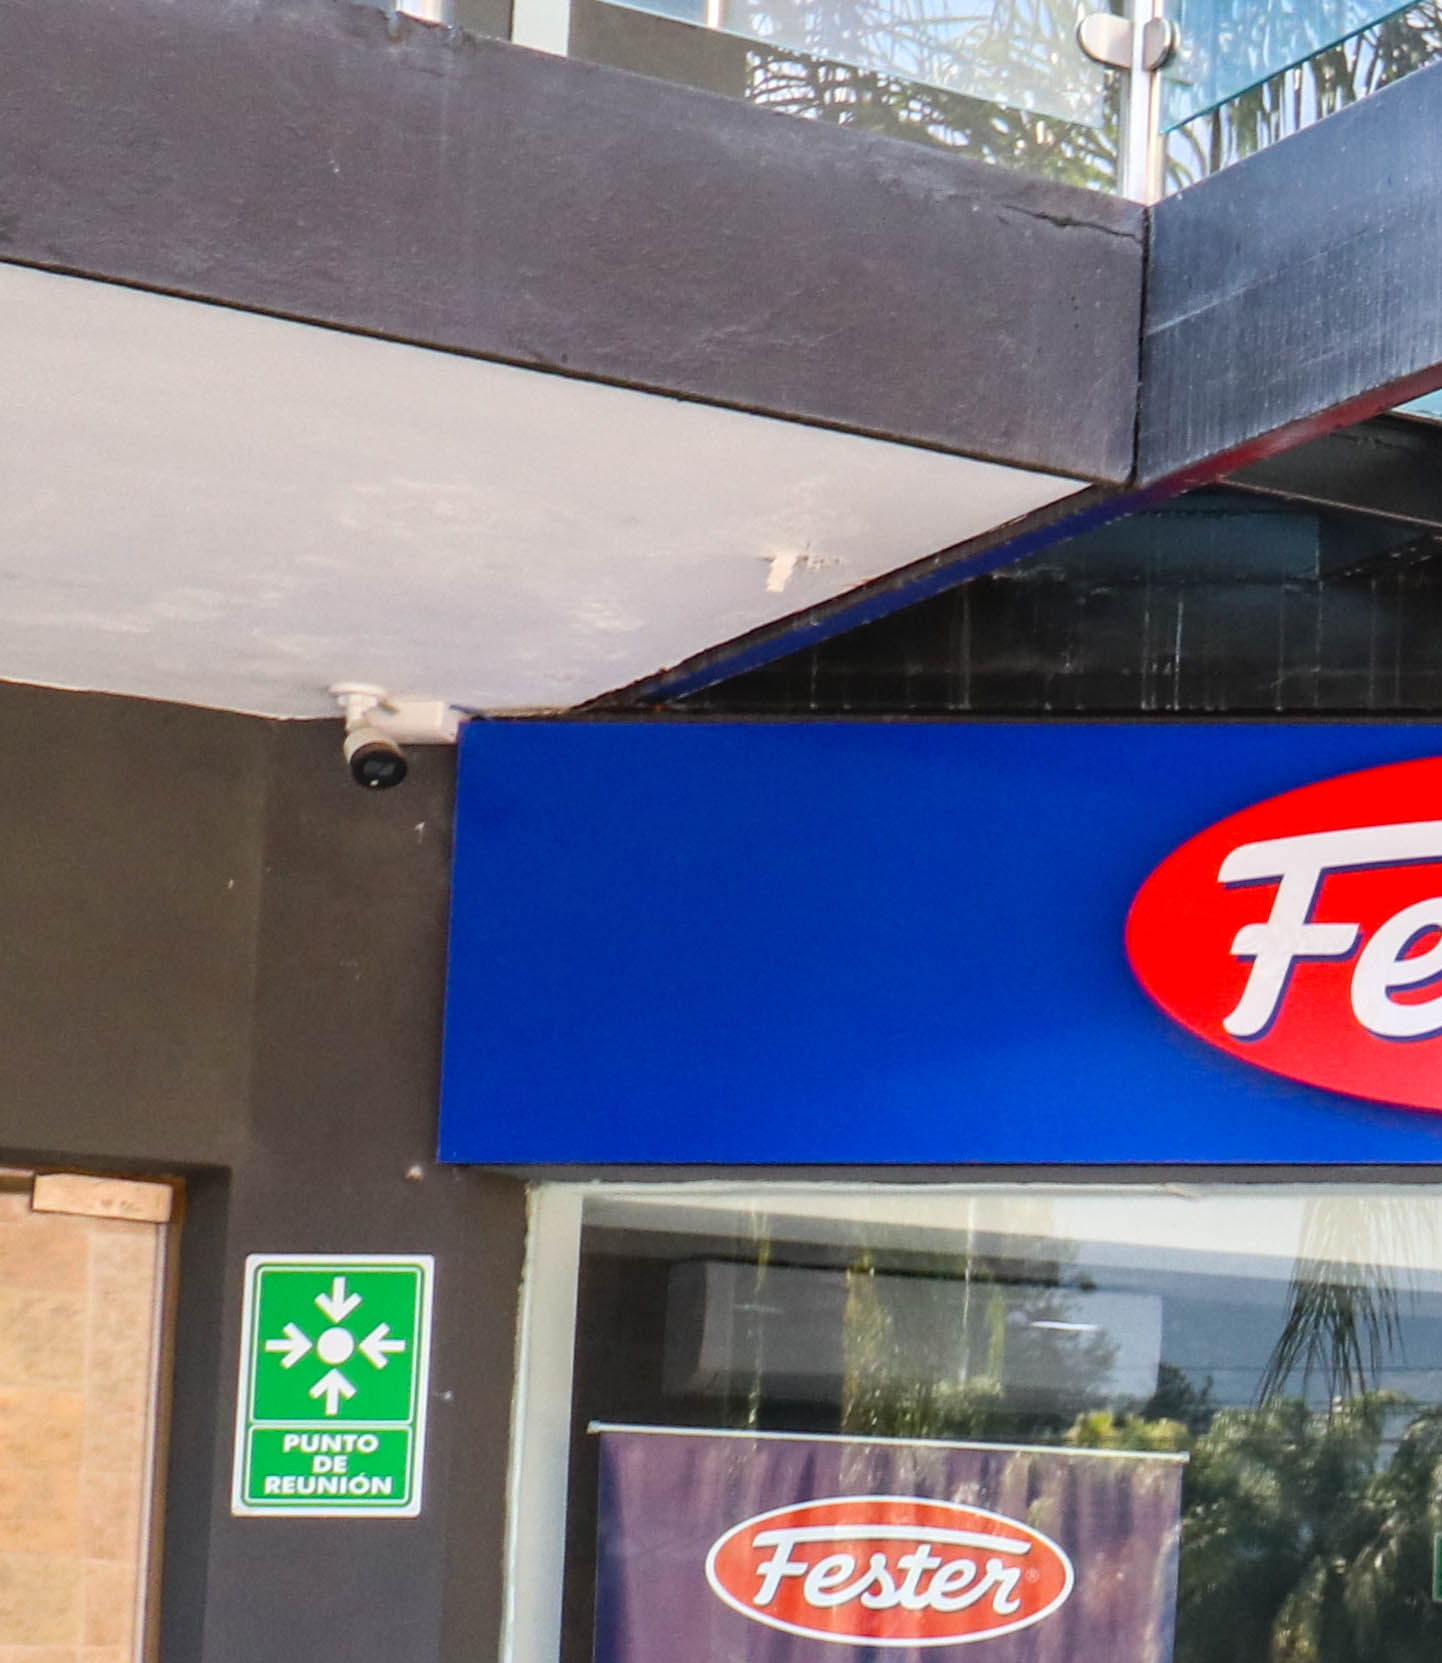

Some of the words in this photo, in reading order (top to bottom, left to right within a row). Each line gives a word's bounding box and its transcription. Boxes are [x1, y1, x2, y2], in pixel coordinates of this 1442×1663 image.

[282, 1433, 379, 1454] PUNTO
[311, 1454, 348, 1475] DE
[263, 1473, 393, 1496] REUNIÓN
